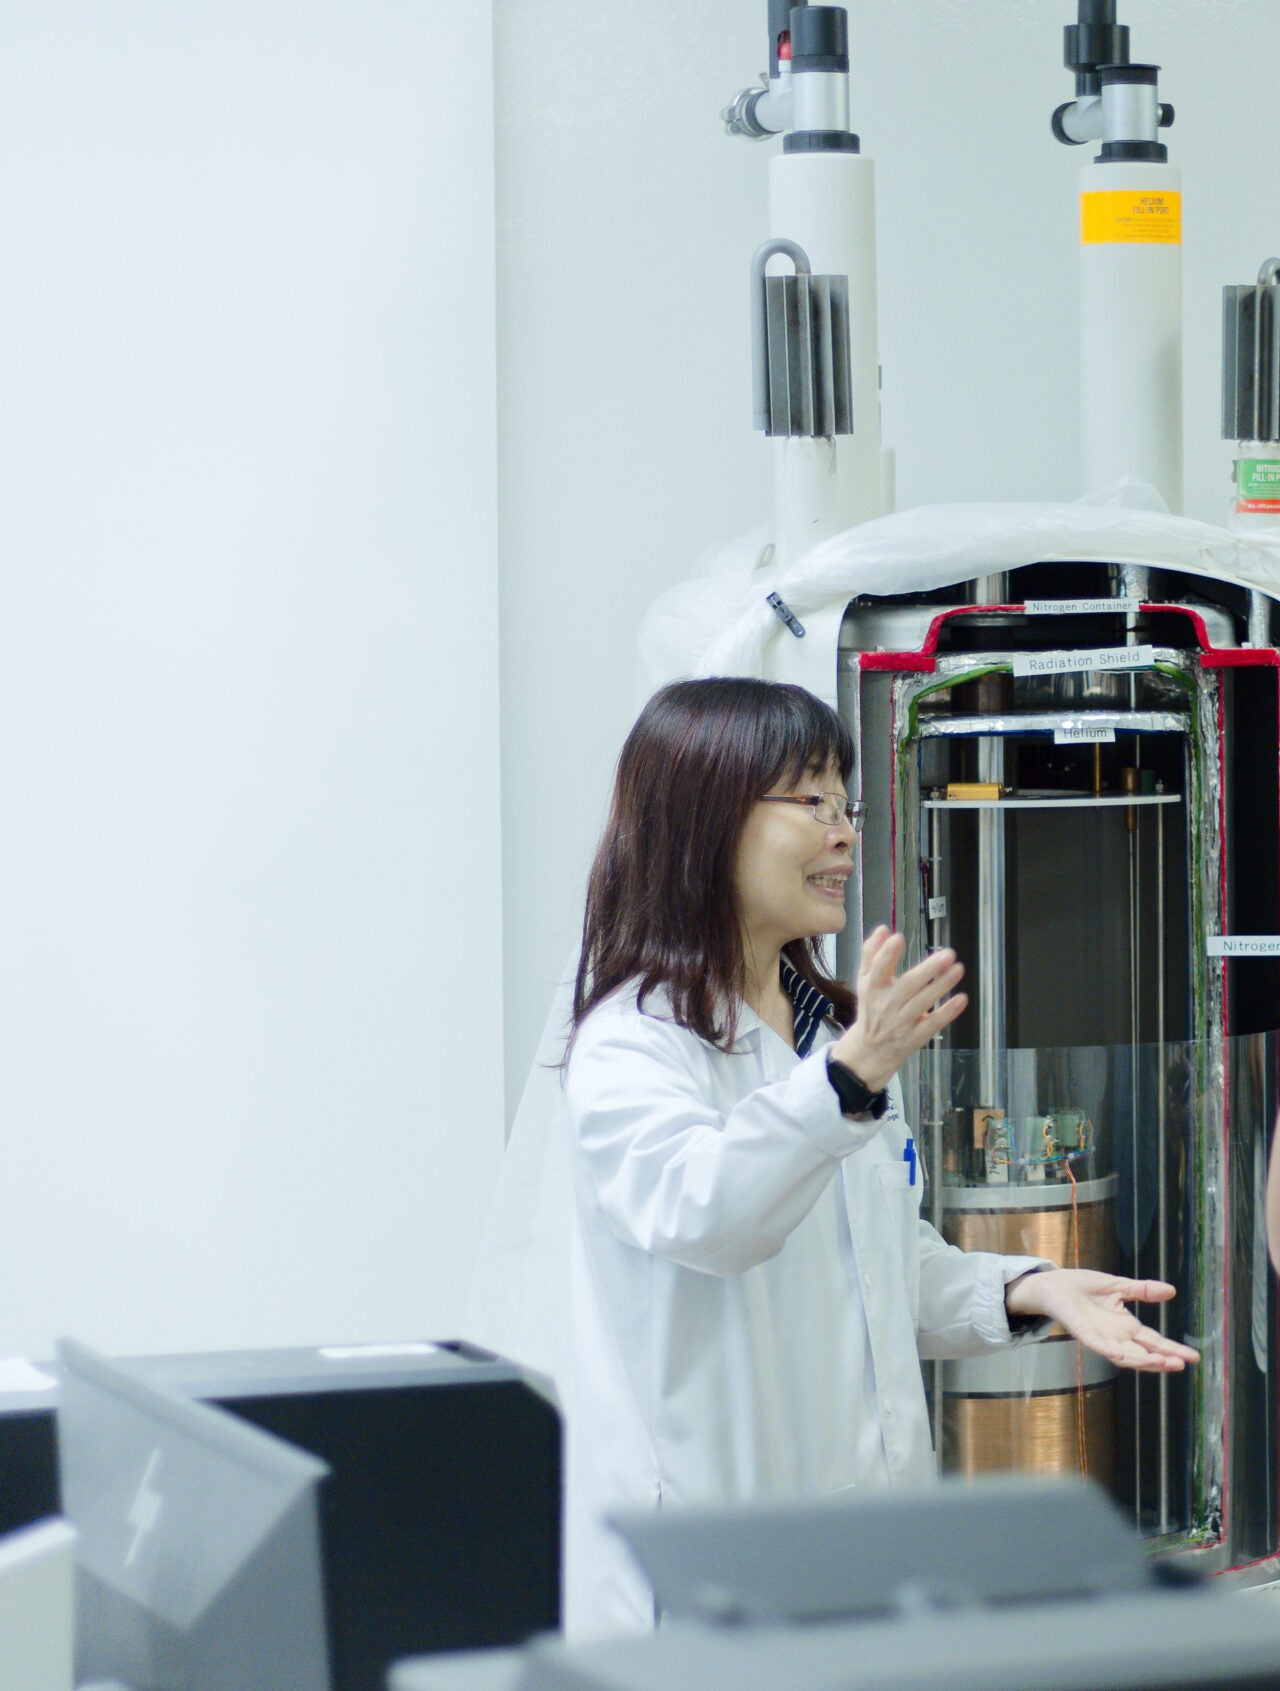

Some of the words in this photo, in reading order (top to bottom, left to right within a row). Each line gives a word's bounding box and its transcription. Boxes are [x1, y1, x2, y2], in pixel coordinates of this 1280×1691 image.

[1156, 206, 1170, 215] PORT
[1033, 603, 1077, 613] Nitrogen
[1082, 602, 1132, 611] Container
[1029, 656, 1093, 671] Radiation
[1099, 651, 1140, 665] Shield
[1063, 728, 1107, 739] Helium
